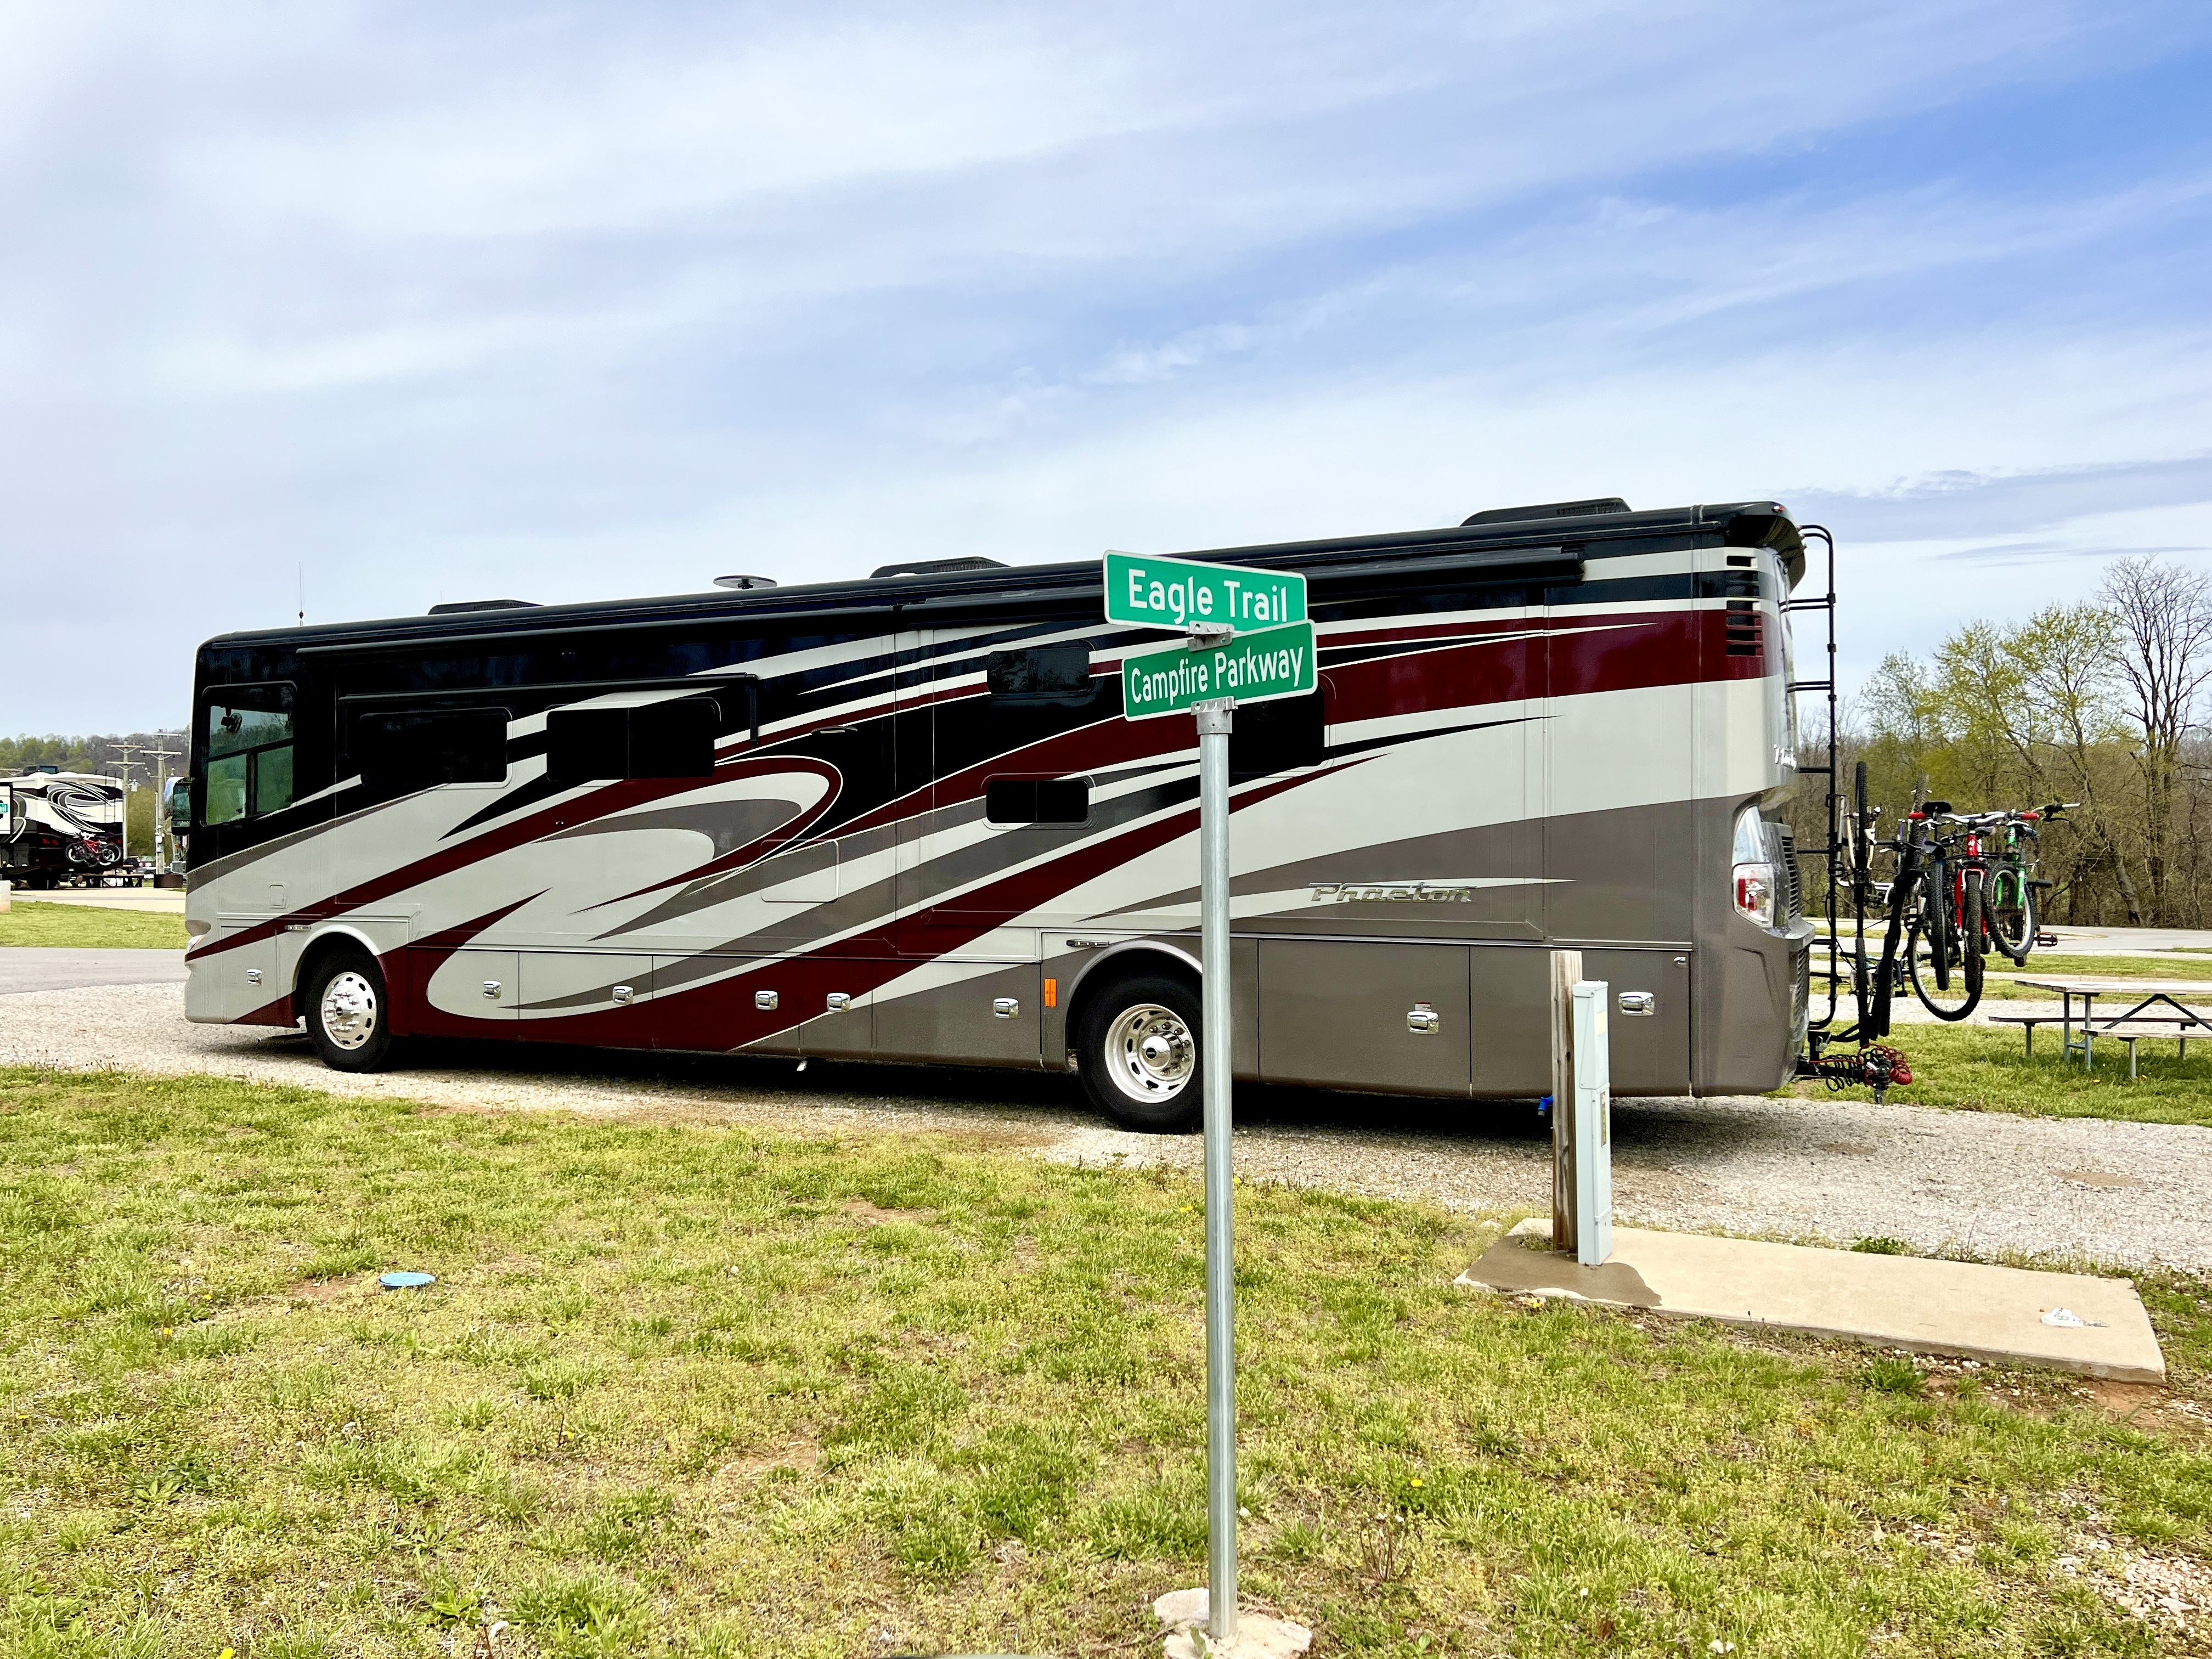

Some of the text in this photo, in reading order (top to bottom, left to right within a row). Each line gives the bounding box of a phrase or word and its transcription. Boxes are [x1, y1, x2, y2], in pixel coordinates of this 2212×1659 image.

[1128, 568, 1288, 625] Eagle Trail
[1131, 646, 1304, 706] Campfire Parkway
[1308, 882, 1477, 903] Phaeton
